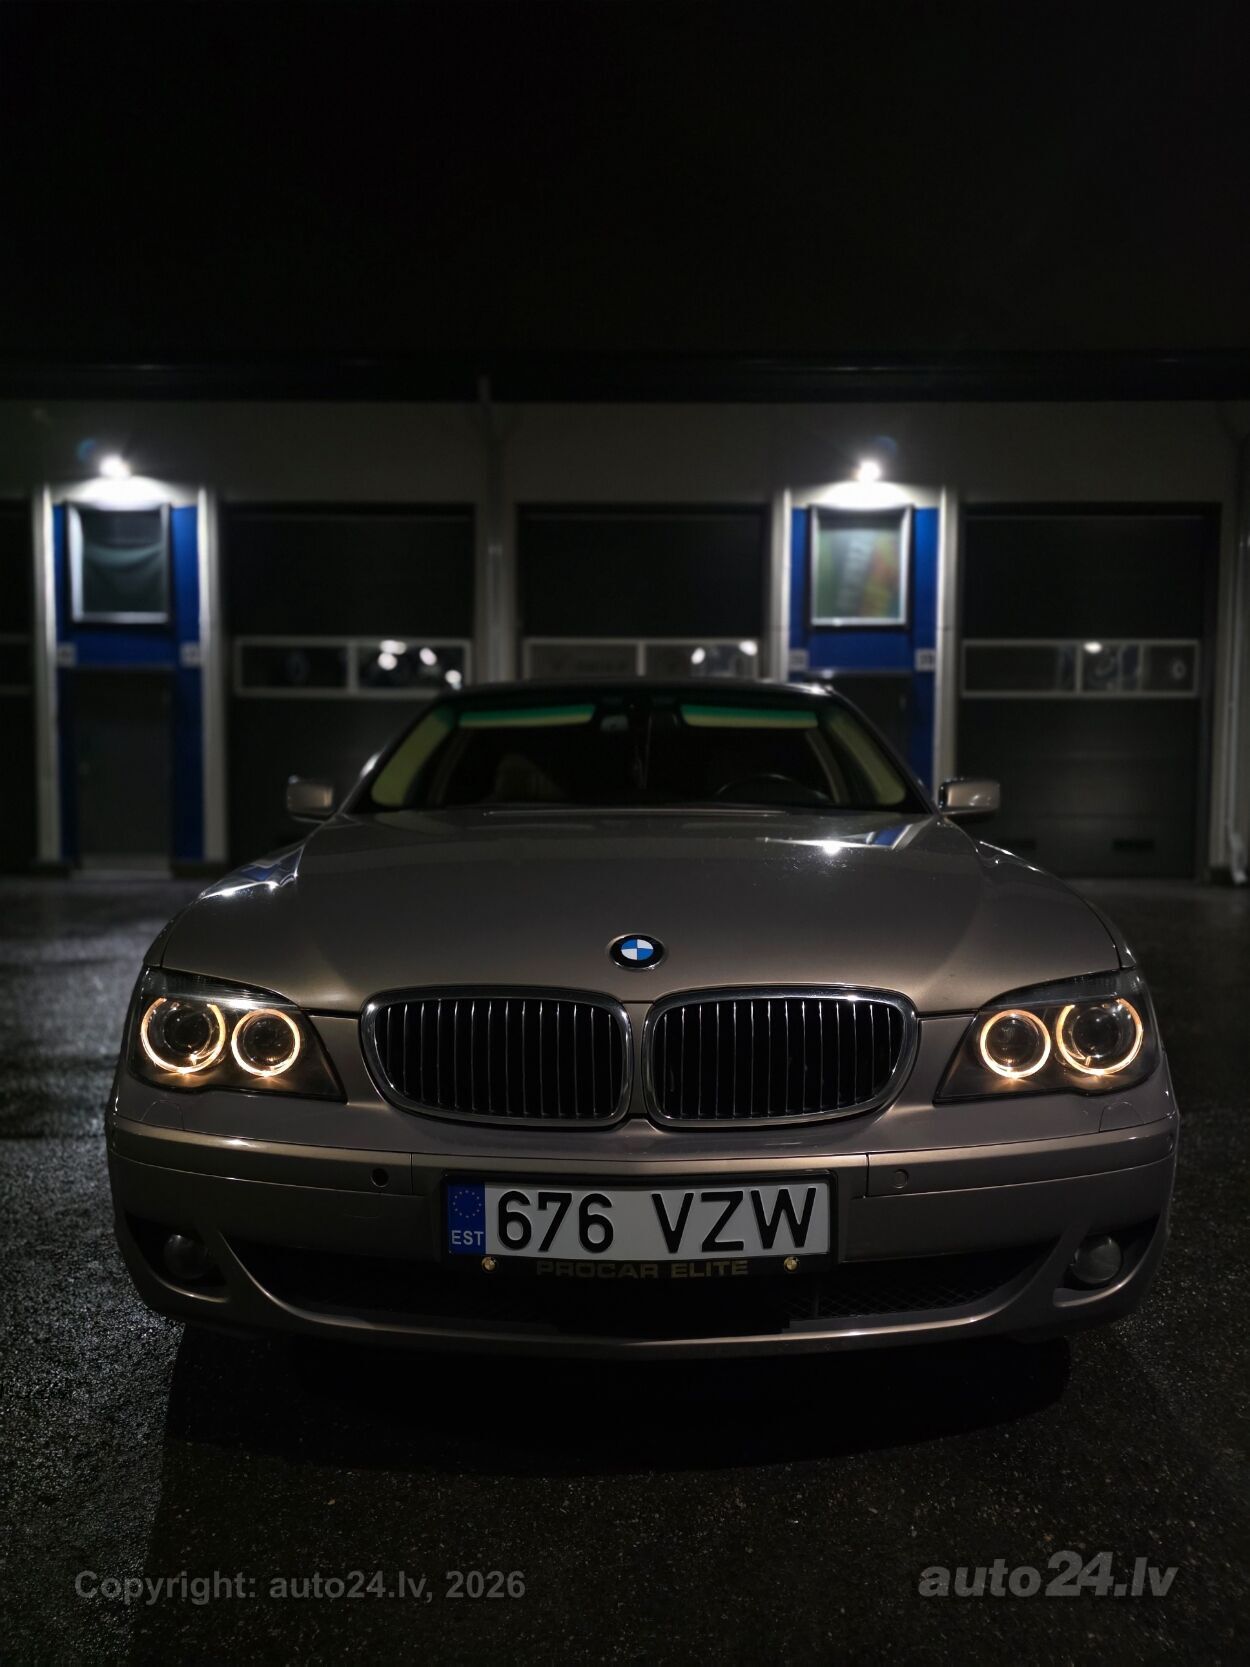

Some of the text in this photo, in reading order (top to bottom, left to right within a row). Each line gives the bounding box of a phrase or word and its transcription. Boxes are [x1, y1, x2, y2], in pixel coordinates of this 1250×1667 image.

[498, 1188, 816, 1253] 676 VZW
[450, 1230, 485, 1246] EST
[536, 1259, 750, 1279] PROCAR ELITE
